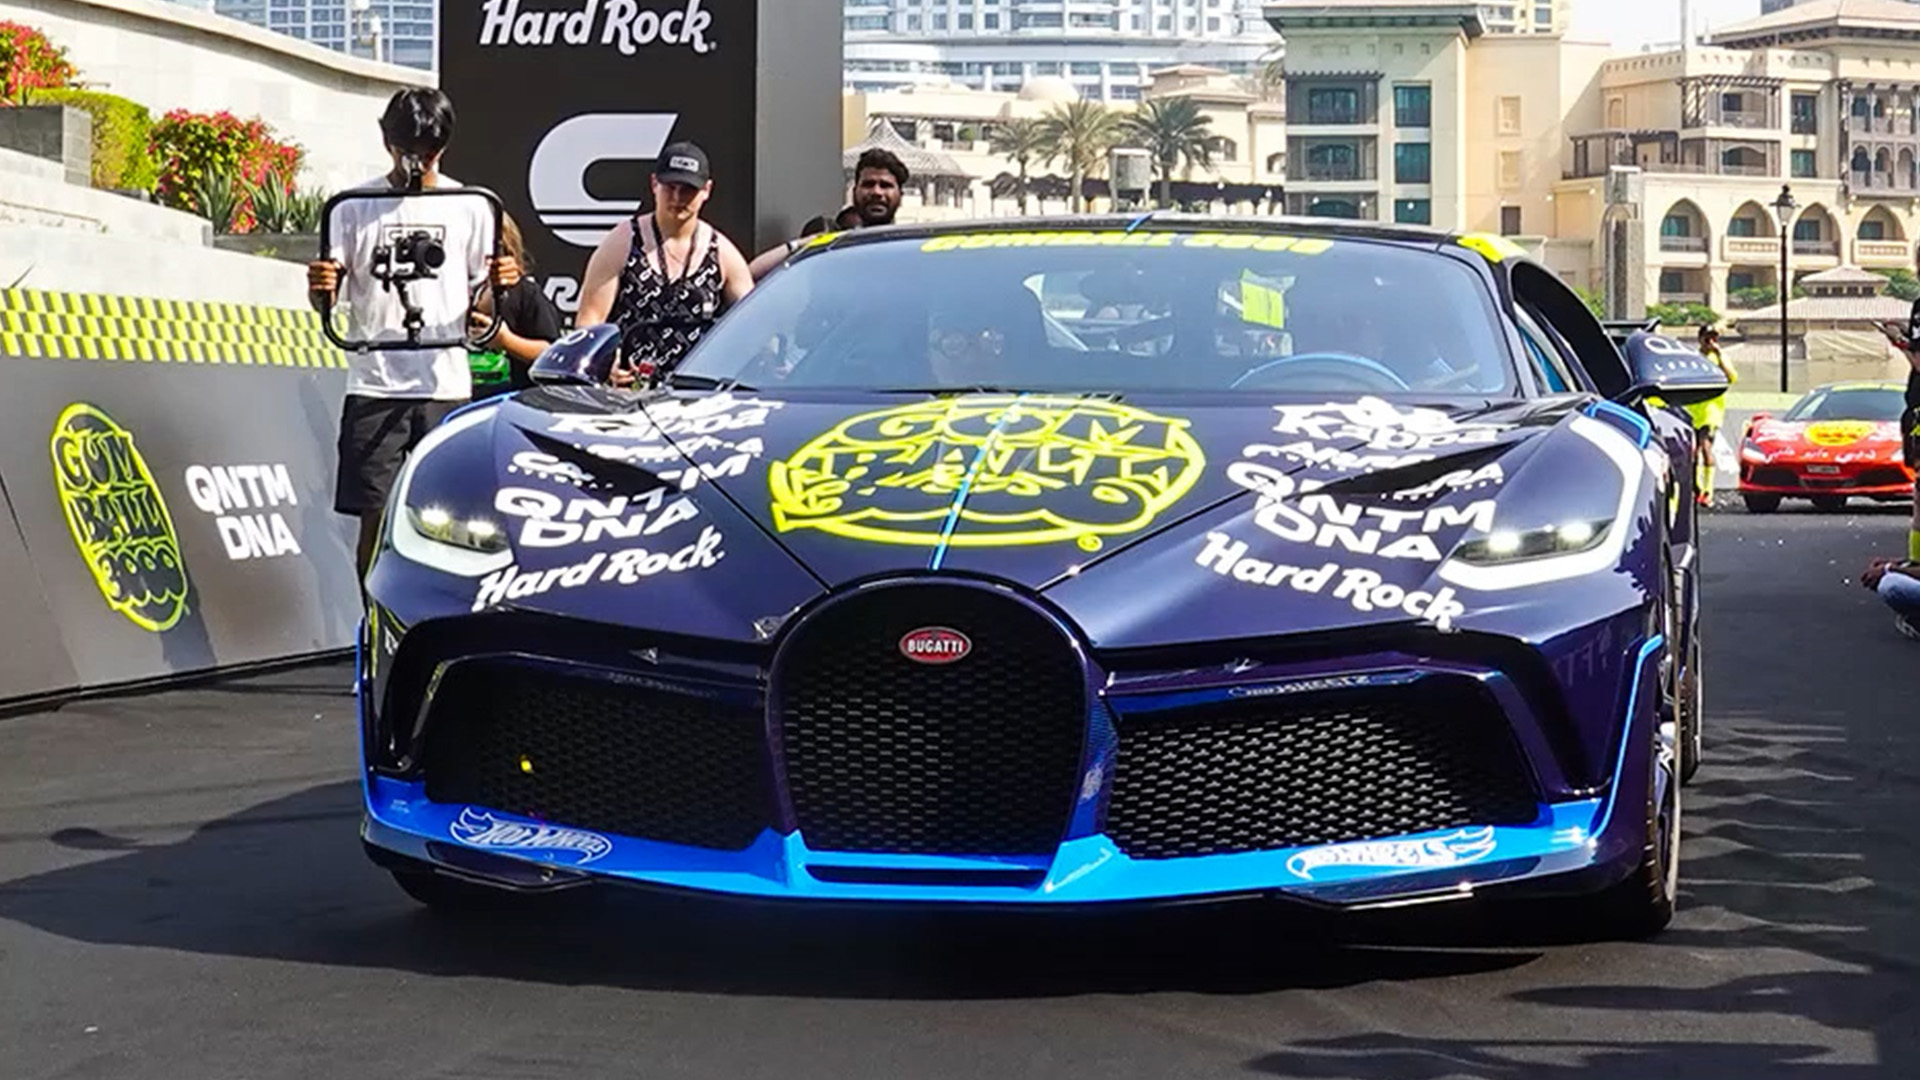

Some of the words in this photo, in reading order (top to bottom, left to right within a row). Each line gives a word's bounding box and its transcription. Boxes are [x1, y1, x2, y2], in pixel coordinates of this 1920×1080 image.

[479, 0, 597, 45] Hard
[600, 0, 712, 55] Rock
[185, 463, 298, 514] QNTM
[1226, 460, 1497, 533] QNTM
[216, 513, 301, 560] DNA
[519, 496, 700, 547] DNA
[1254, 494, 1443, 561] DNA
[471, 552, 606, 613] Hard
[600, 525, 725, 585] Rock
[1195, 530, 1340, 594] Hard
[1332, 566, 1465, 633] Rock
[907, 639, 964, 654] BUGATTI
